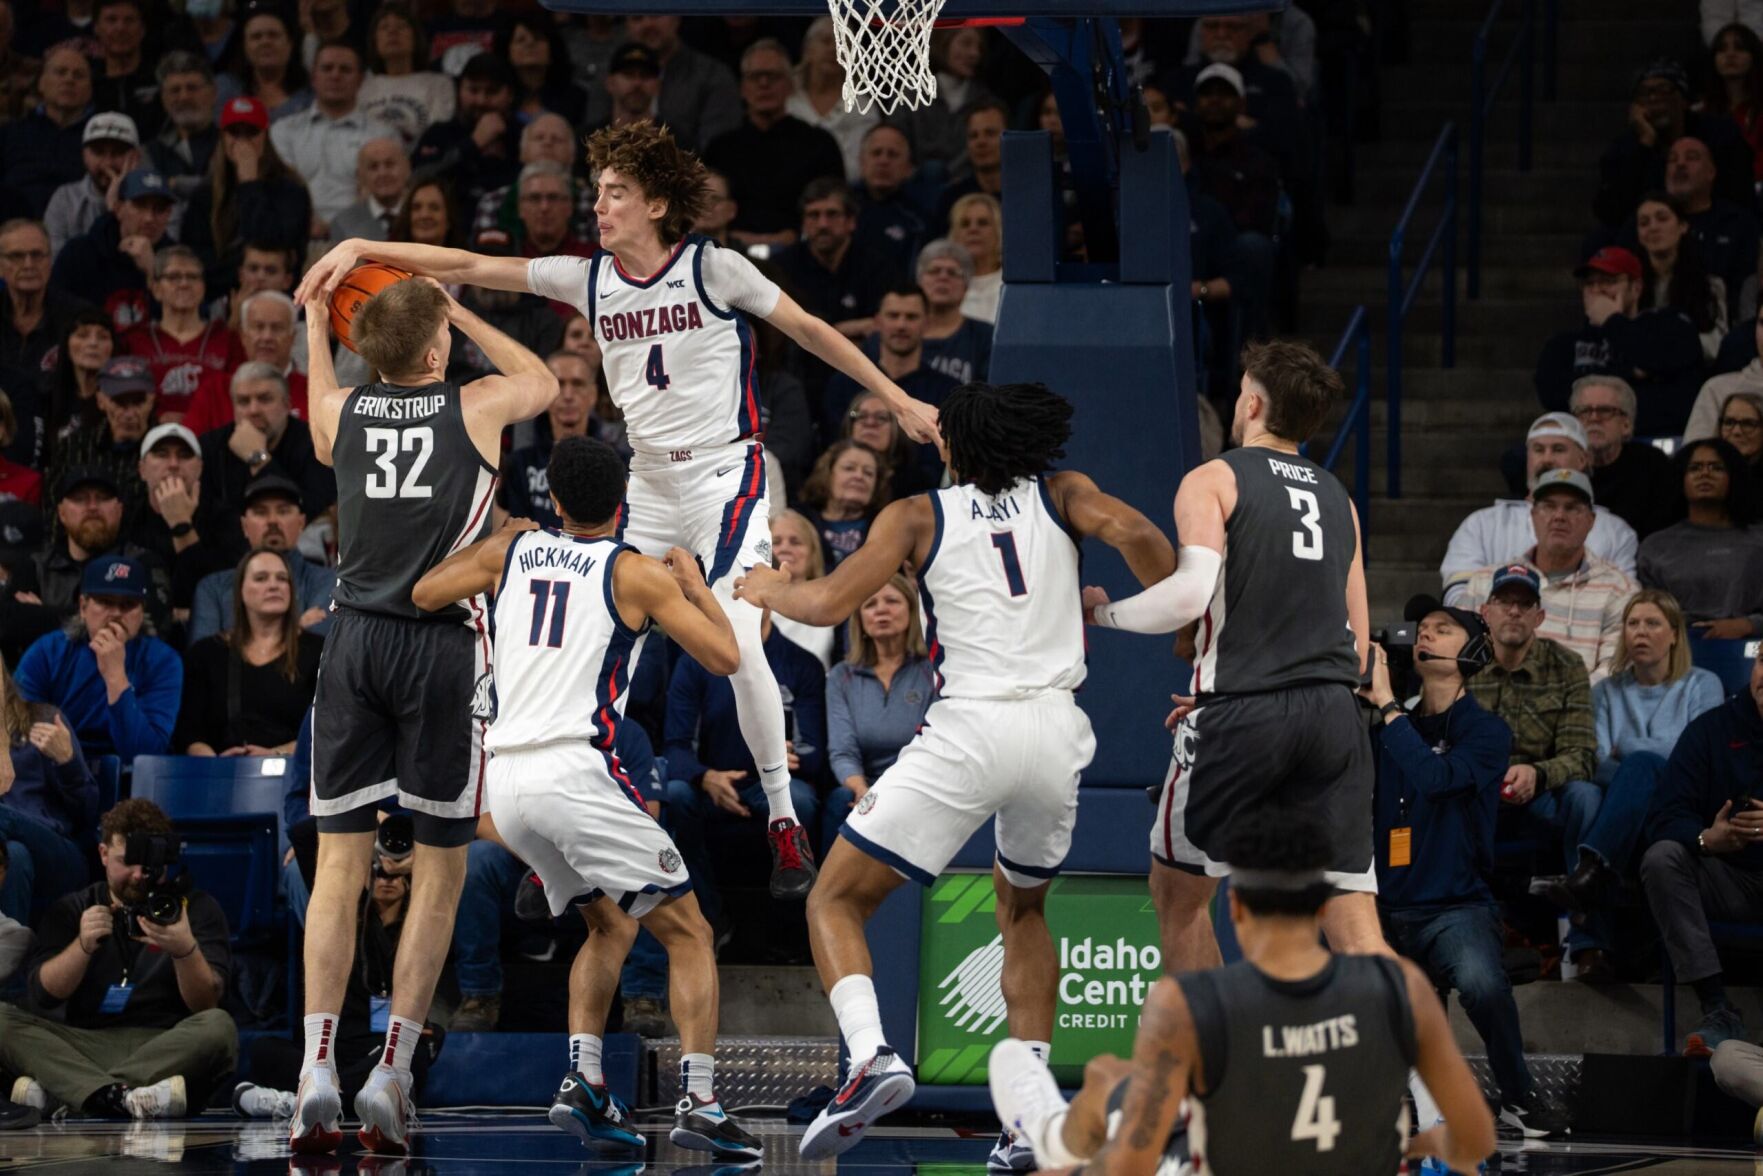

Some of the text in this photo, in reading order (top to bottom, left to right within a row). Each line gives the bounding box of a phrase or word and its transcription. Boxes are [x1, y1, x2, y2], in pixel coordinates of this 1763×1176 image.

[599, 302, 703, 342] GONZAGA
[646, 344, 670, 390] 4
[353, 394, 446, 419] ERIKSTRUP
[363, 426, 434, 498] 32
[669, 450, 692, 462] ZAGS
[1267, 458, 1318, 484] PRICE
[1284, 485, 1323, 561] 3
[519, 546, 596, 578] HICKMAN
[990, 530, 1028, 597] 1
[528, 578, 571, 648] 11
[1060, 936, 1161, 970] Idaho
[1059, 1013, 1128, 1028] CREDIT
[1262, 1013, 1359, 1058] L.WATTS
[1290, 1064, 1342, 1152] 4
